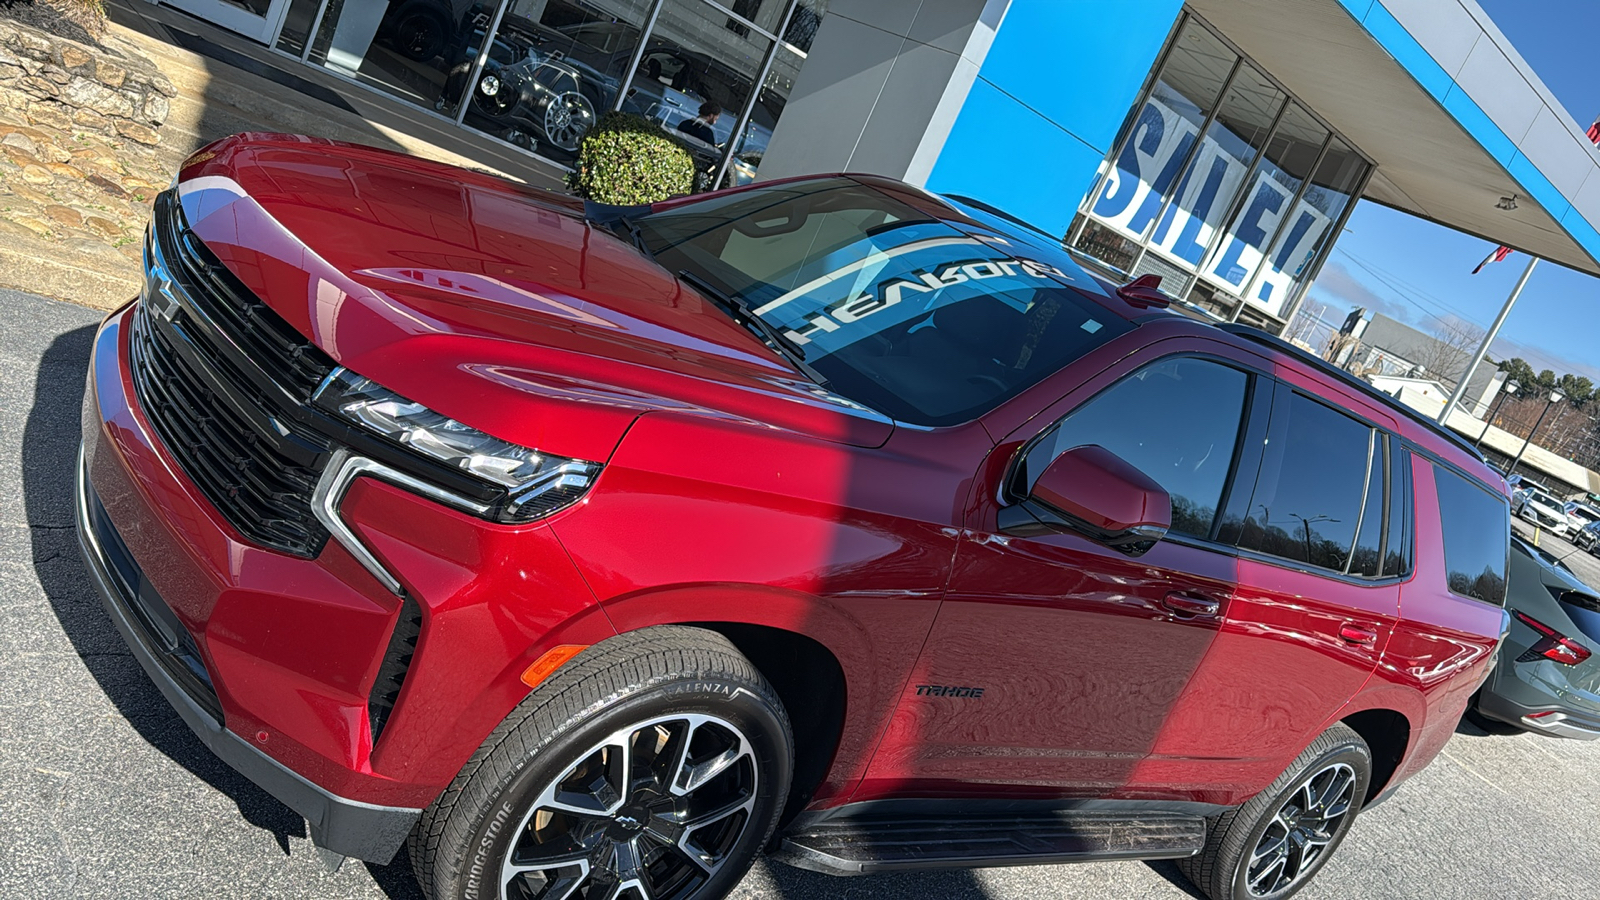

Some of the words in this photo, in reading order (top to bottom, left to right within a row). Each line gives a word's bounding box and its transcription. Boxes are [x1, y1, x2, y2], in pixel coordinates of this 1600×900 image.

[1088, 102, 1316, 304] SALE!
[675, 682, 730, 695] ALENZA
[915, 684, 985, 698] TAHOE
[464, 800, 515, 900] BRIDGESTONE
